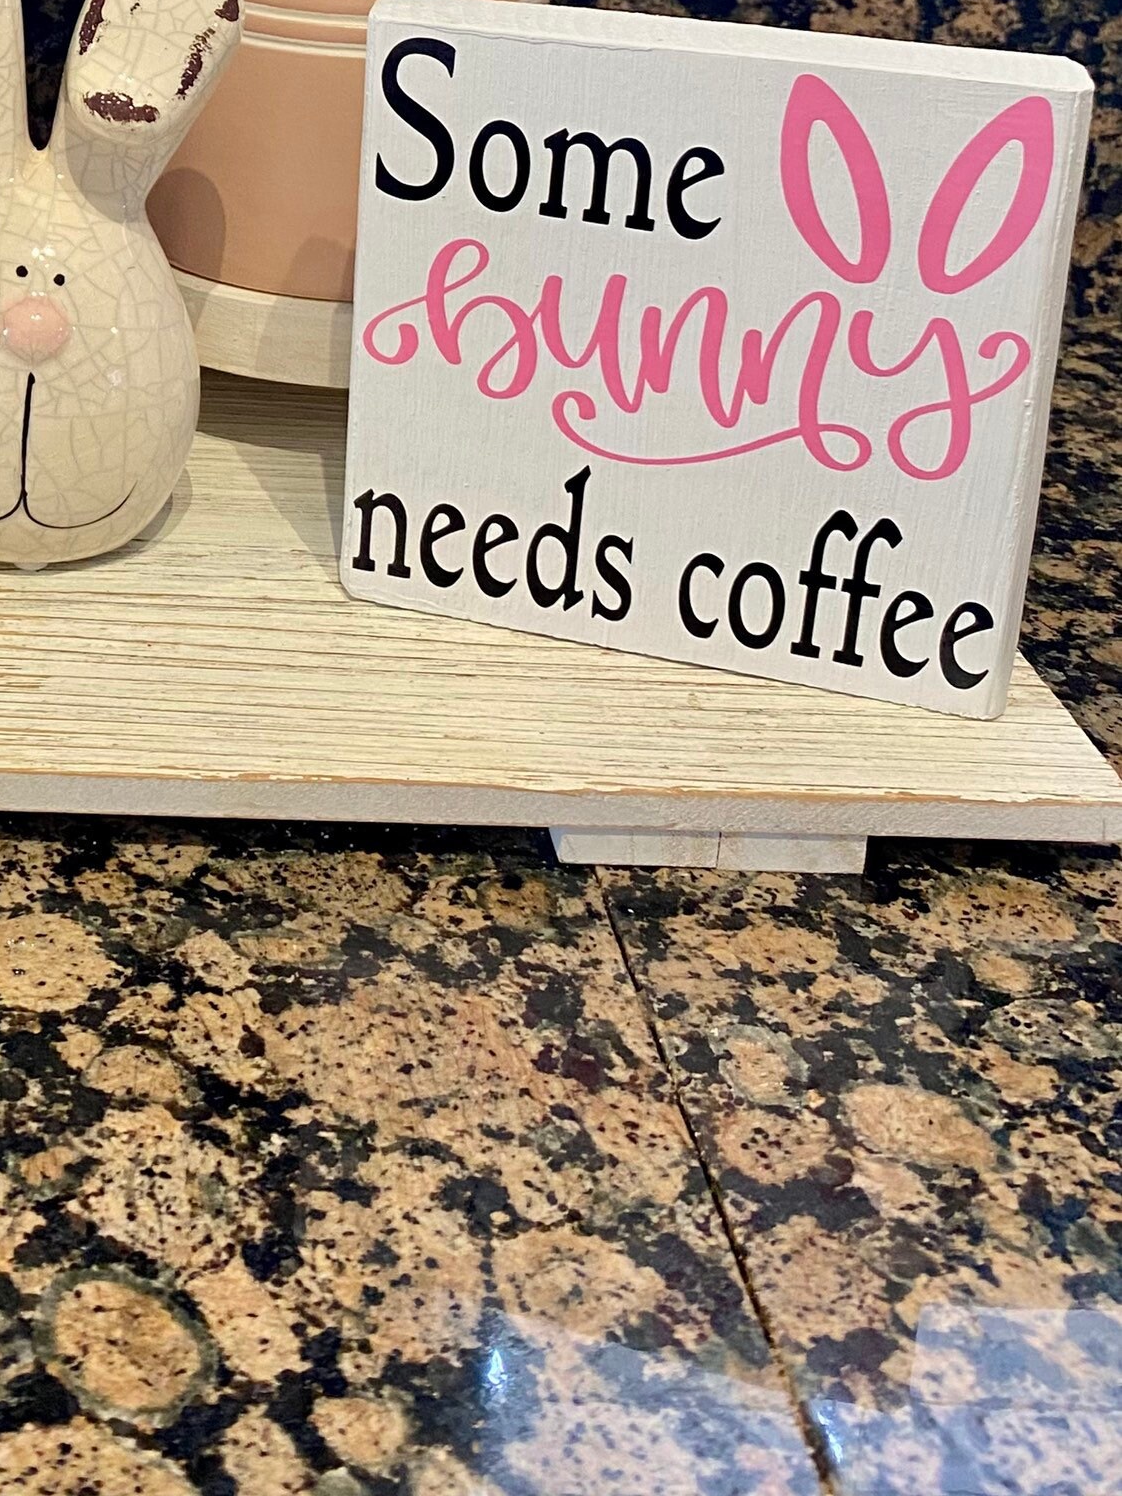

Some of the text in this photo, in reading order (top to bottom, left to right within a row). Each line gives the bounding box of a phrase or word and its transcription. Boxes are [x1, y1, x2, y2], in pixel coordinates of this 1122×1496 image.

[375, 37, 725, 240] Some
[363, 238, 1031, 481] bunny
[352, 465, 996, 690] needs coffee
